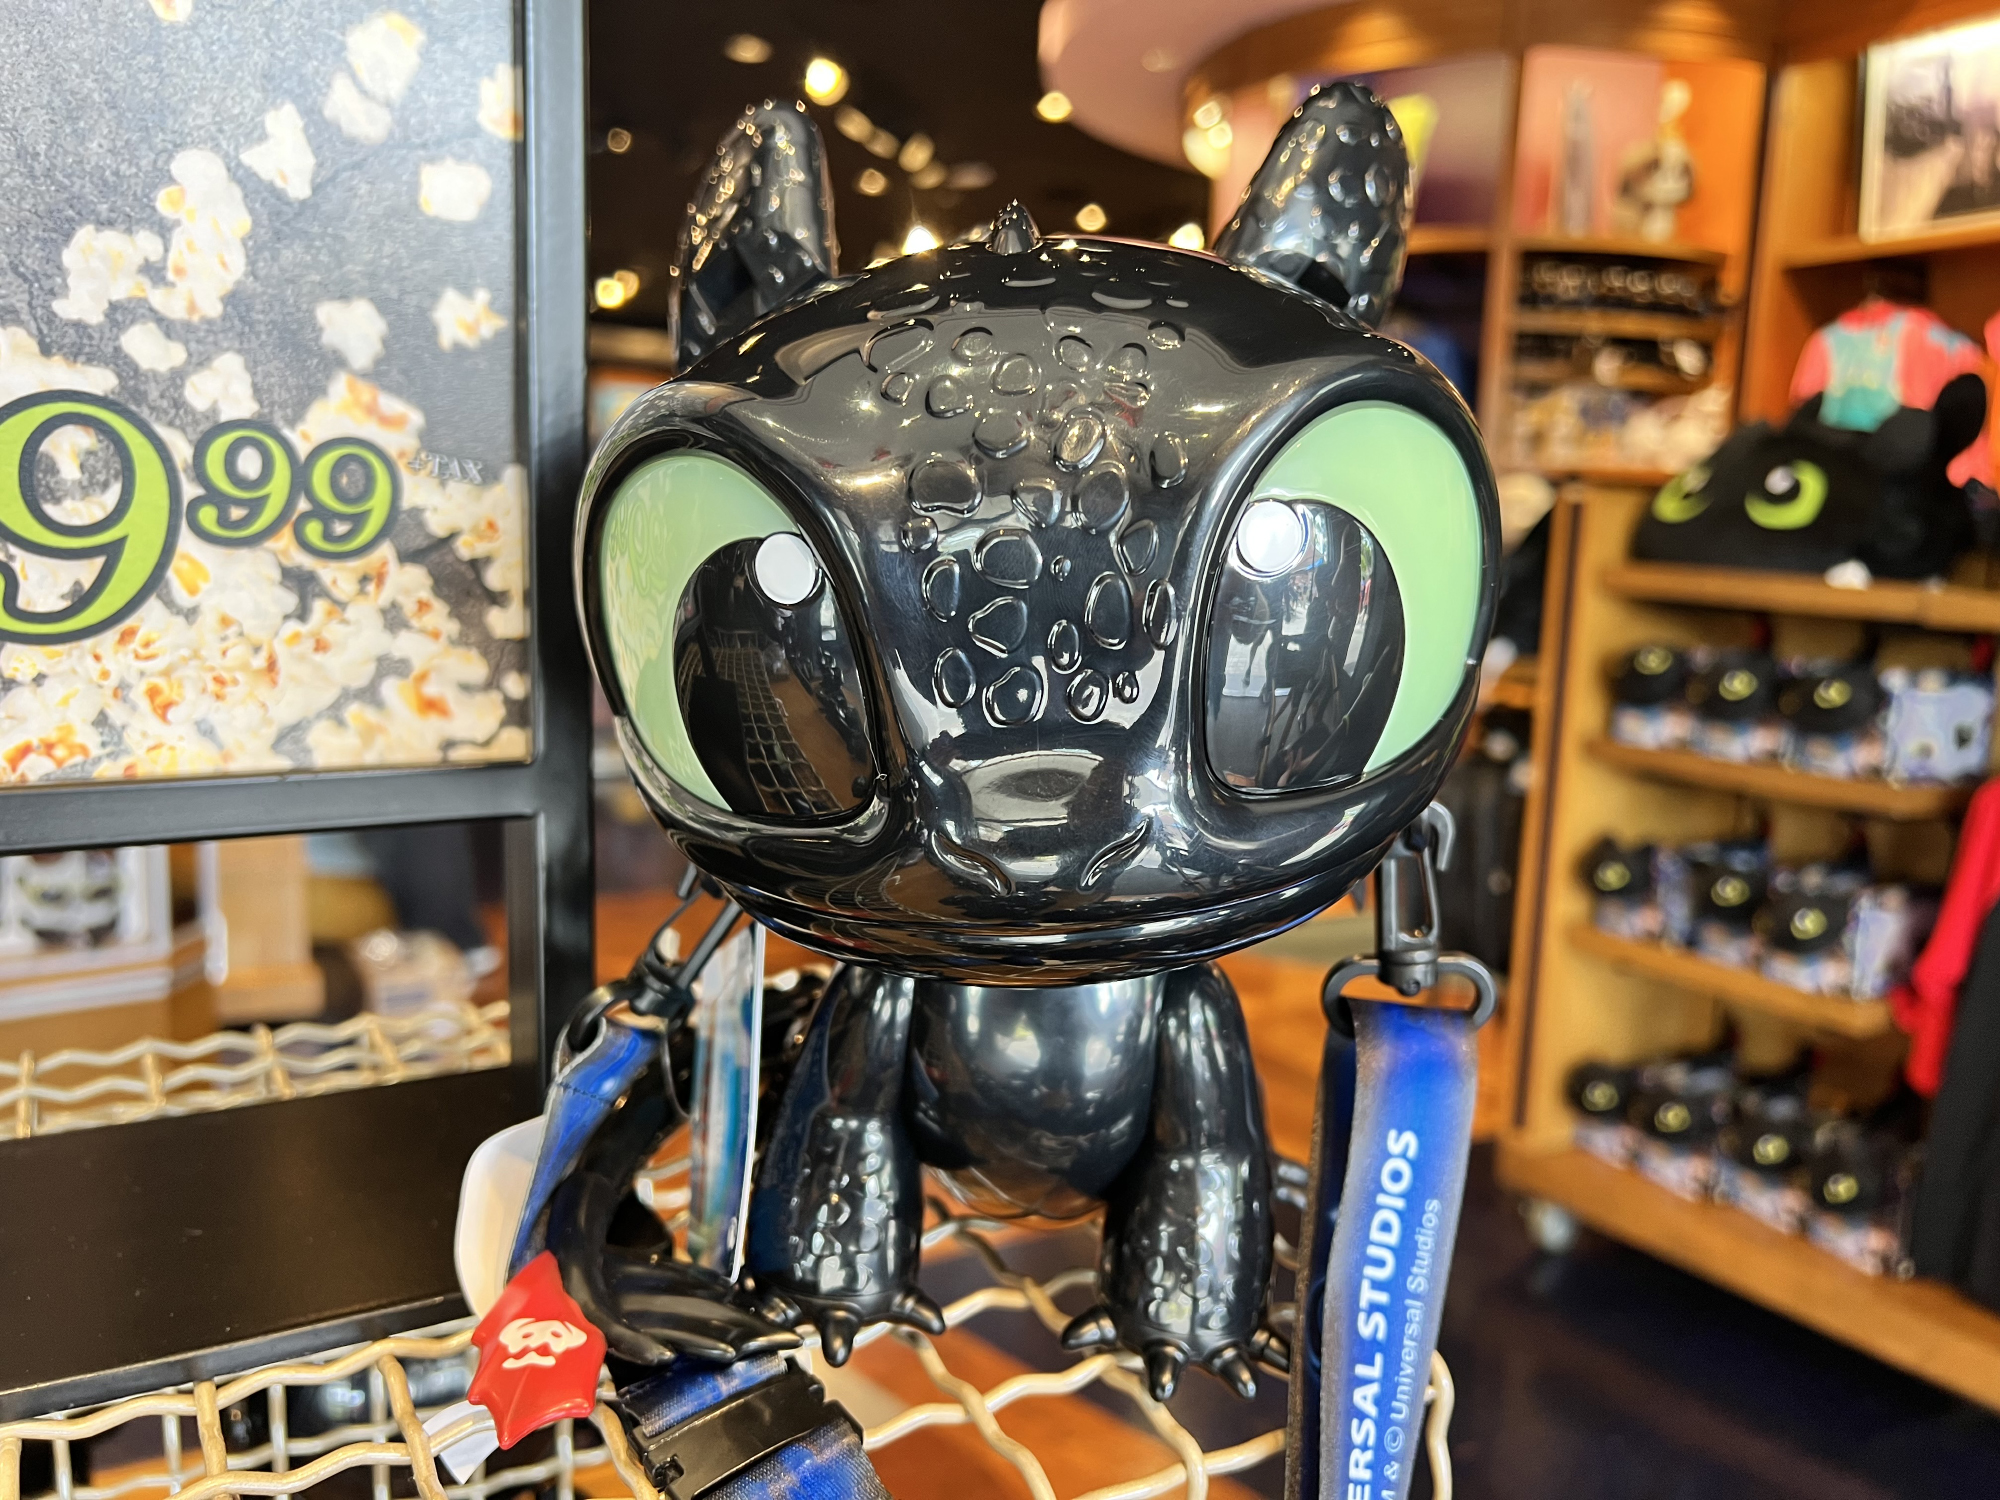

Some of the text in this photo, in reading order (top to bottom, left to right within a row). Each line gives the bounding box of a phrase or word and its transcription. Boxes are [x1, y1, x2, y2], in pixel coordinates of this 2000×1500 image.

[1357, 1128, 1419, 1342] STUDIOS
[1406, 1199, 1441, 1294] Studios
[1389, 1299, 1424, 1421] Universal
